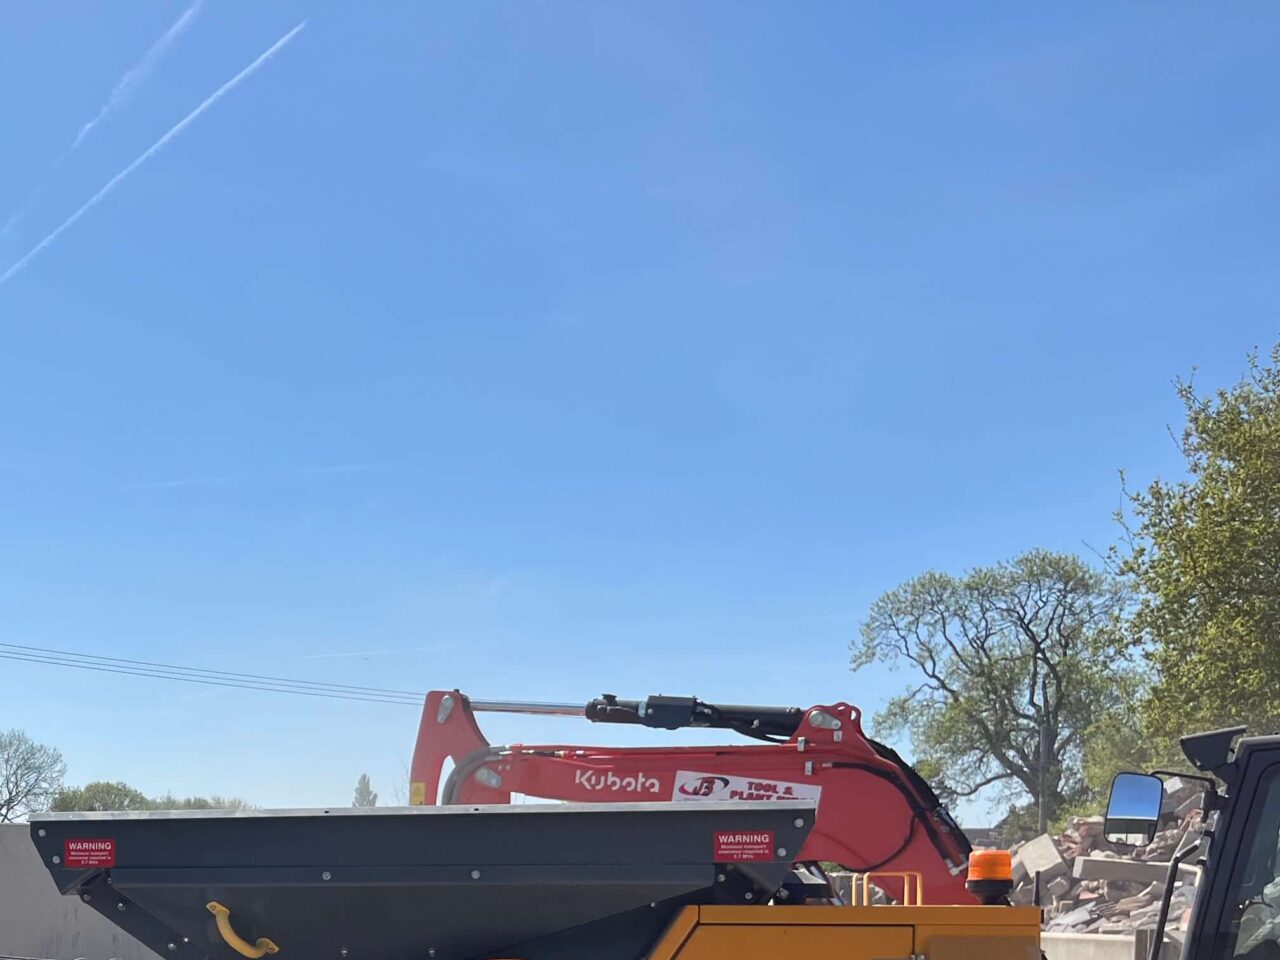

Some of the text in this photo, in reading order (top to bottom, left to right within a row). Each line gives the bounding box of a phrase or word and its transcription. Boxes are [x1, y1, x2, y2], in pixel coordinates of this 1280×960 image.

[575, 769, 660, 793] Kubota
[747, 781, 793, 795] TOOL &
[729, 790, 773, 801] PLANT
[718, 834, 769, 843] WARNING
[68, 842, 112, 850] WARNING
